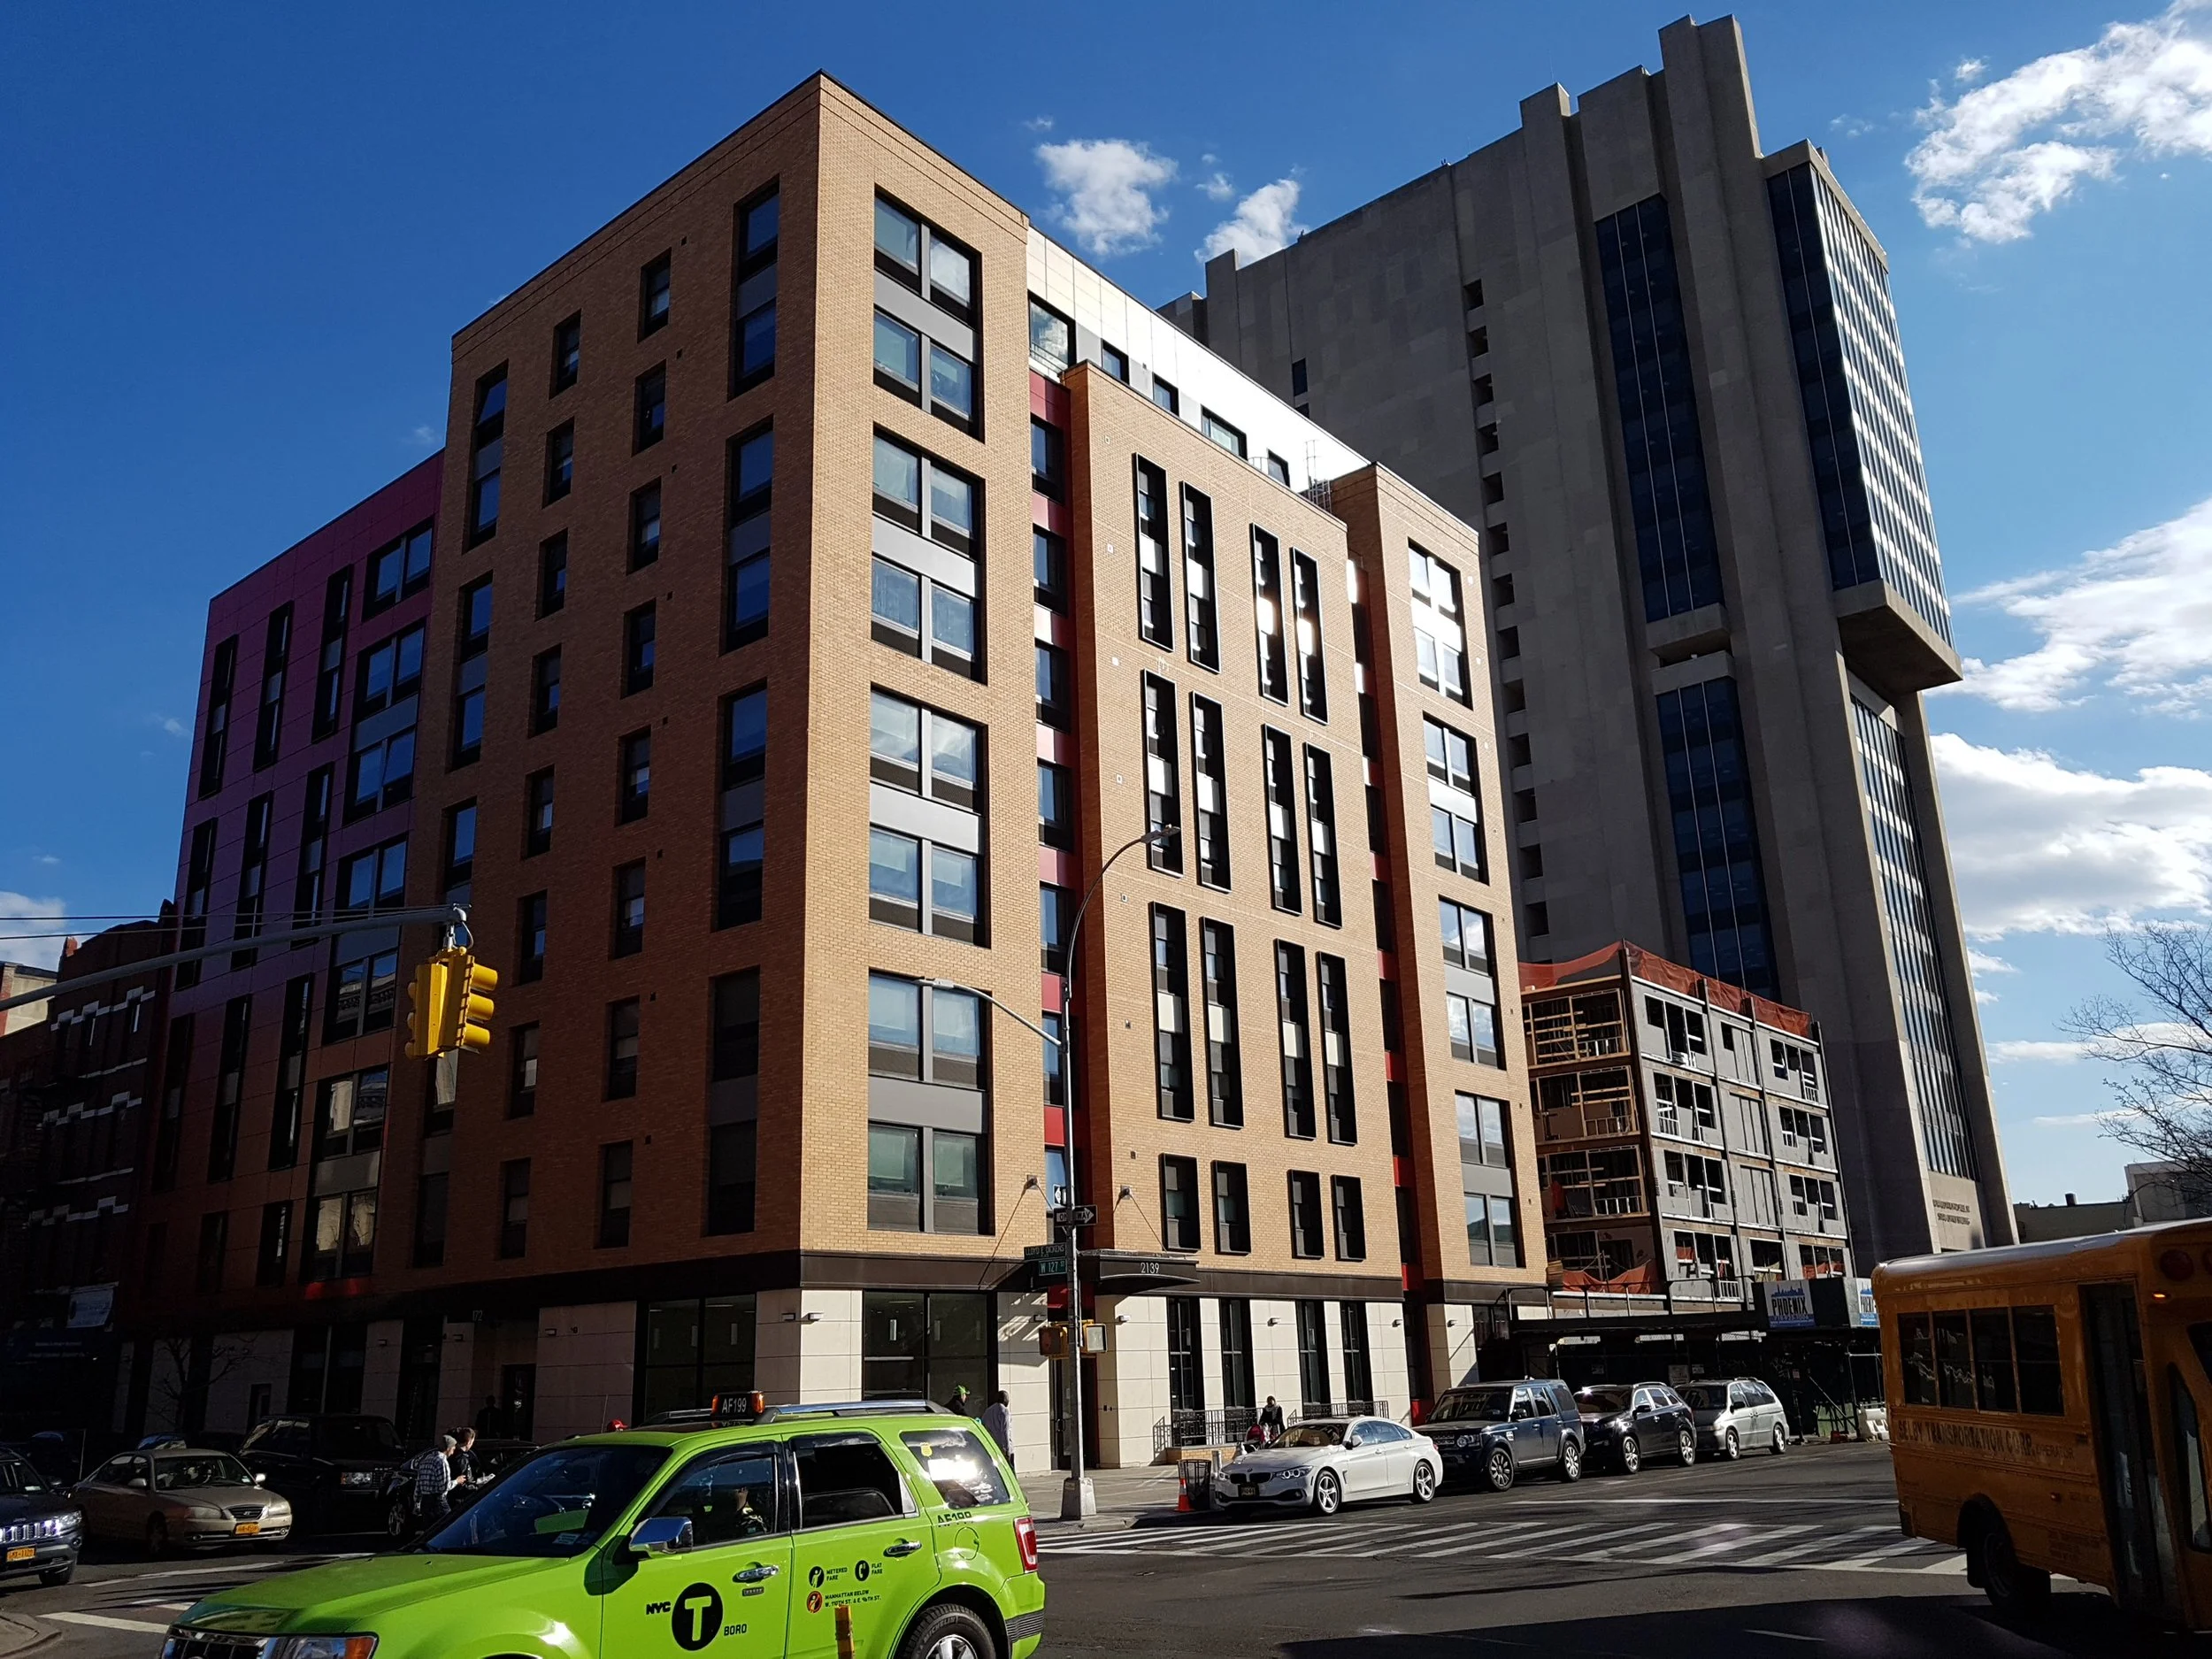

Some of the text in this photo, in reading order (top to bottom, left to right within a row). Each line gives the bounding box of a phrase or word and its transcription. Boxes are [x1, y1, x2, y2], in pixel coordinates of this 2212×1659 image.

[1041, 1263, 1046, 1273] W
[1048, 1262, 1058, 1272] 127
[1141, 1263, 1159, 1274] 2139
[1771, 1296, 1808, 1316] PHOENIX
[722, 1398, 747, 1413] AF199
[1898, 1420, 1921, 1441] SELBY
[1925, 1421, 2004, 1452] TRANSPORTATION
[2036, 1443, 2074, 1459] OPERATOR
[937, 1511, 972, 1527] AF199
[825, 1591, 854, 1600] MANHATTAN
[646, 1601, 671, 1615] NYC
[685, 1595, 711, 1641] T
[724, 1624, 747, 1636] BORO
